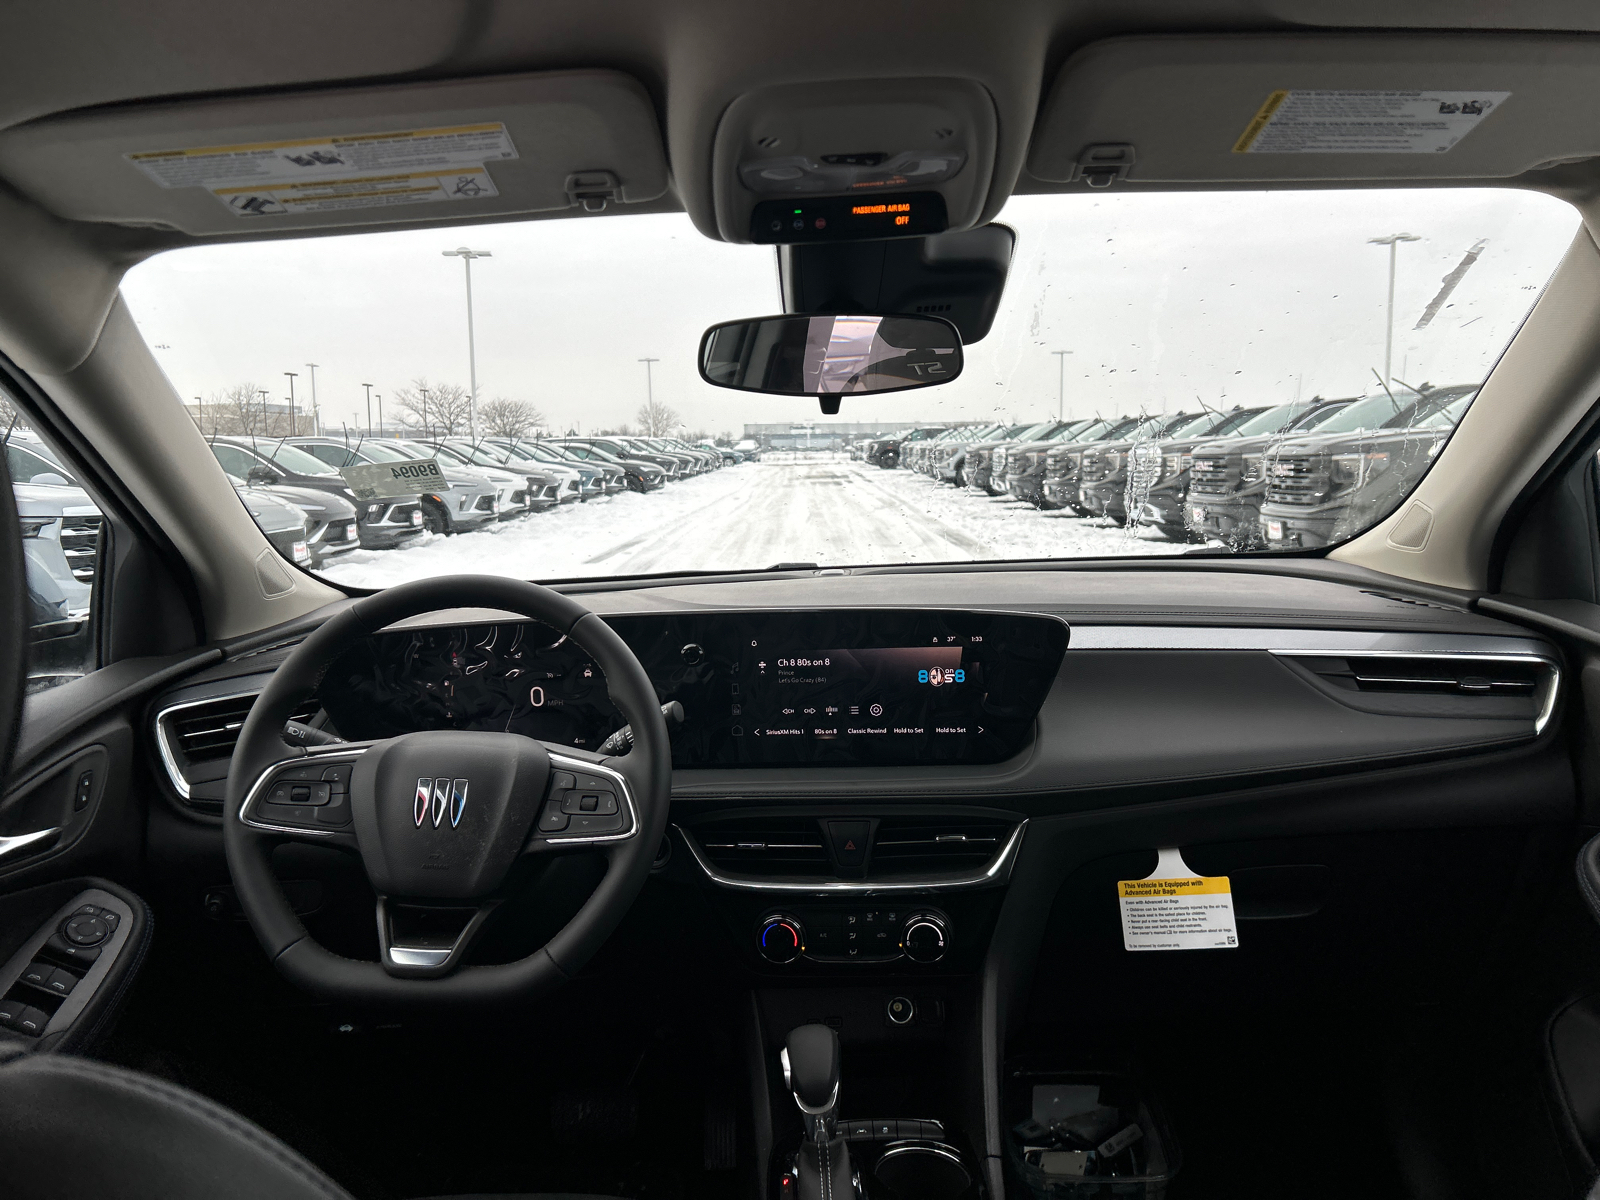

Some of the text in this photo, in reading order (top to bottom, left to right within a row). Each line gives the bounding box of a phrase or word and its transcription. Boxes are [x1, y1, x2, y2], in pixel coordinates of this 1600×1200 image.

[852, 204, 887, 214] PASSENGER
[895, 216, 910, 225] OFF
[824, 658, 830, 666] 8
[530, 686, 544, 708] 0
